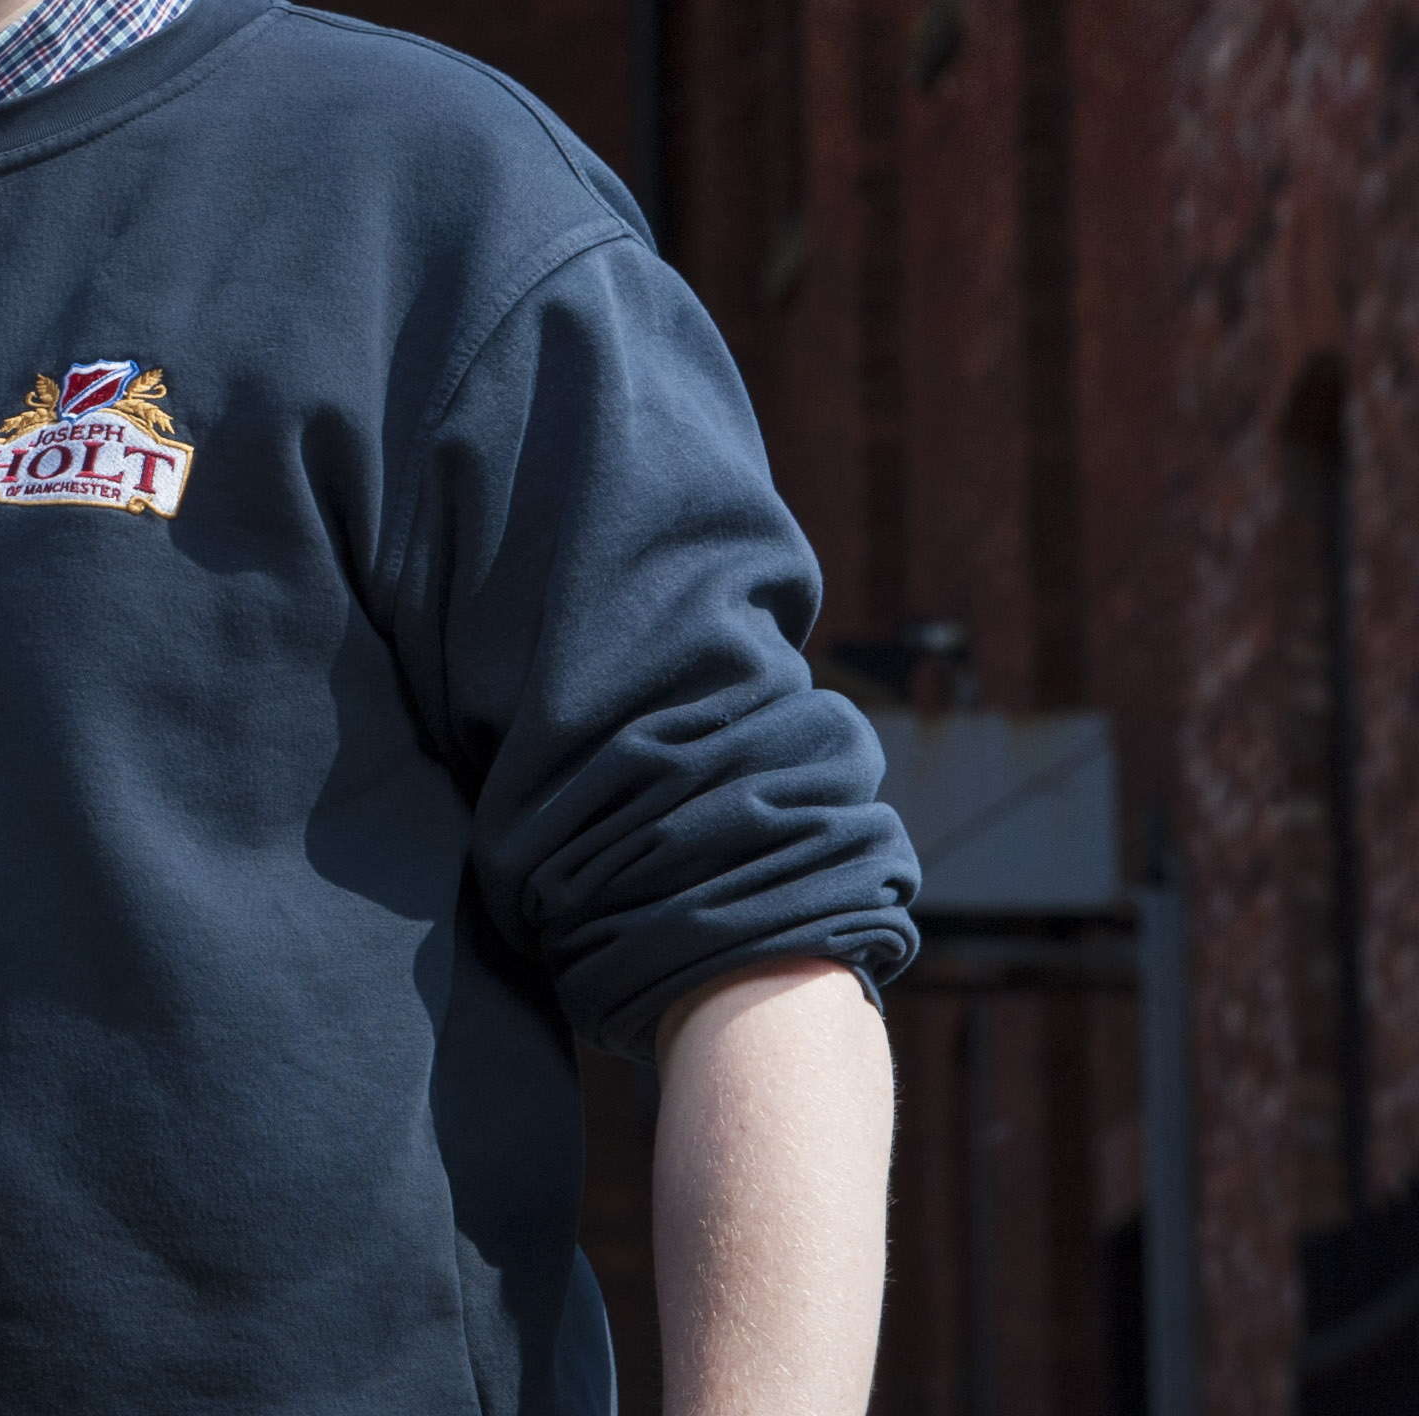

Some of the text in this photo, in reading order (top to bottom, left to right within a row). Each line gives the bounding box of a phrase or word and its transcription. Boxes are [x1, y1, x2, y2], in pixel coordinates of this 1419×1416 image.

[29, 423, 125, 447] JOSEPH
[6, 482, 122, 501] OF MANCHESTER
